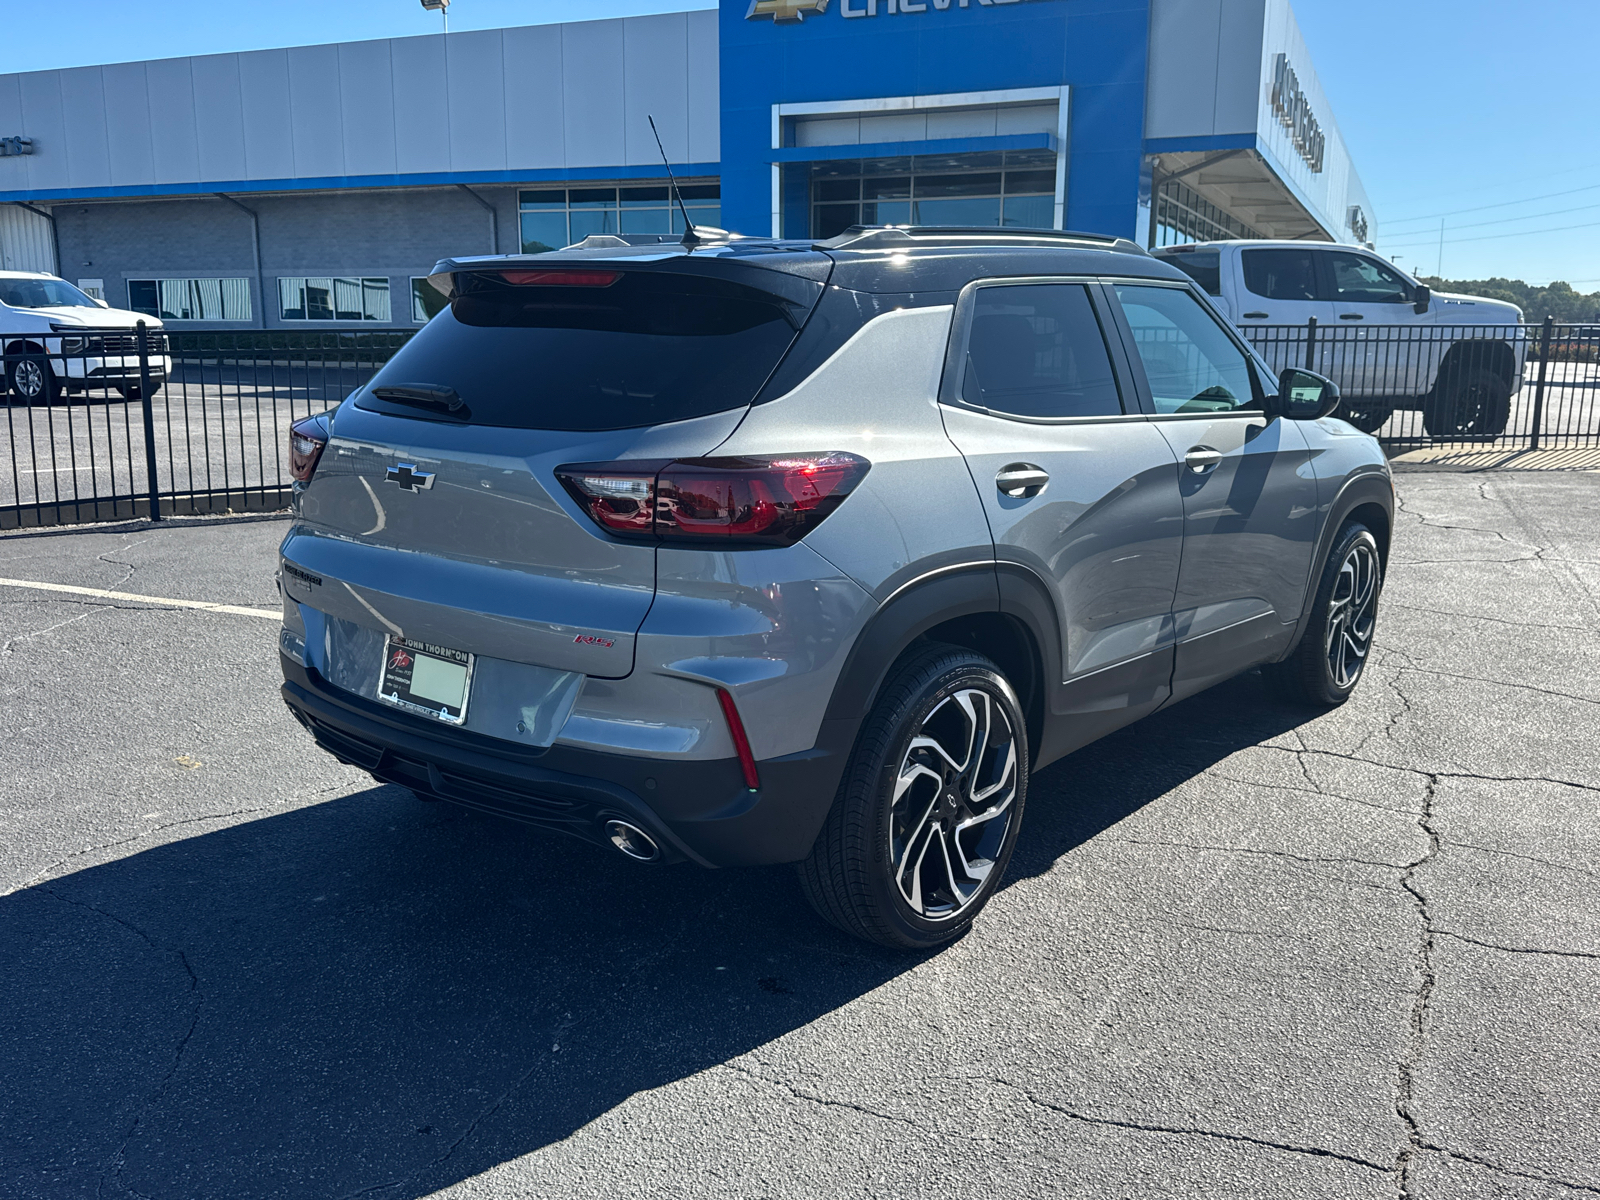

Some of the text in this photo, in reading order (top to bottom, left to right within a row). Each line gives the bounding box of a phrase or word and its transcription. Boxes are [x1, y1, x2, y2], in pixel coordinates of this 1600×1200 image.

[404, 638, 425, 650] JOHN
[573, 634, 616, 648] RS
[405, 703, 431, 715] CHEVROLET
